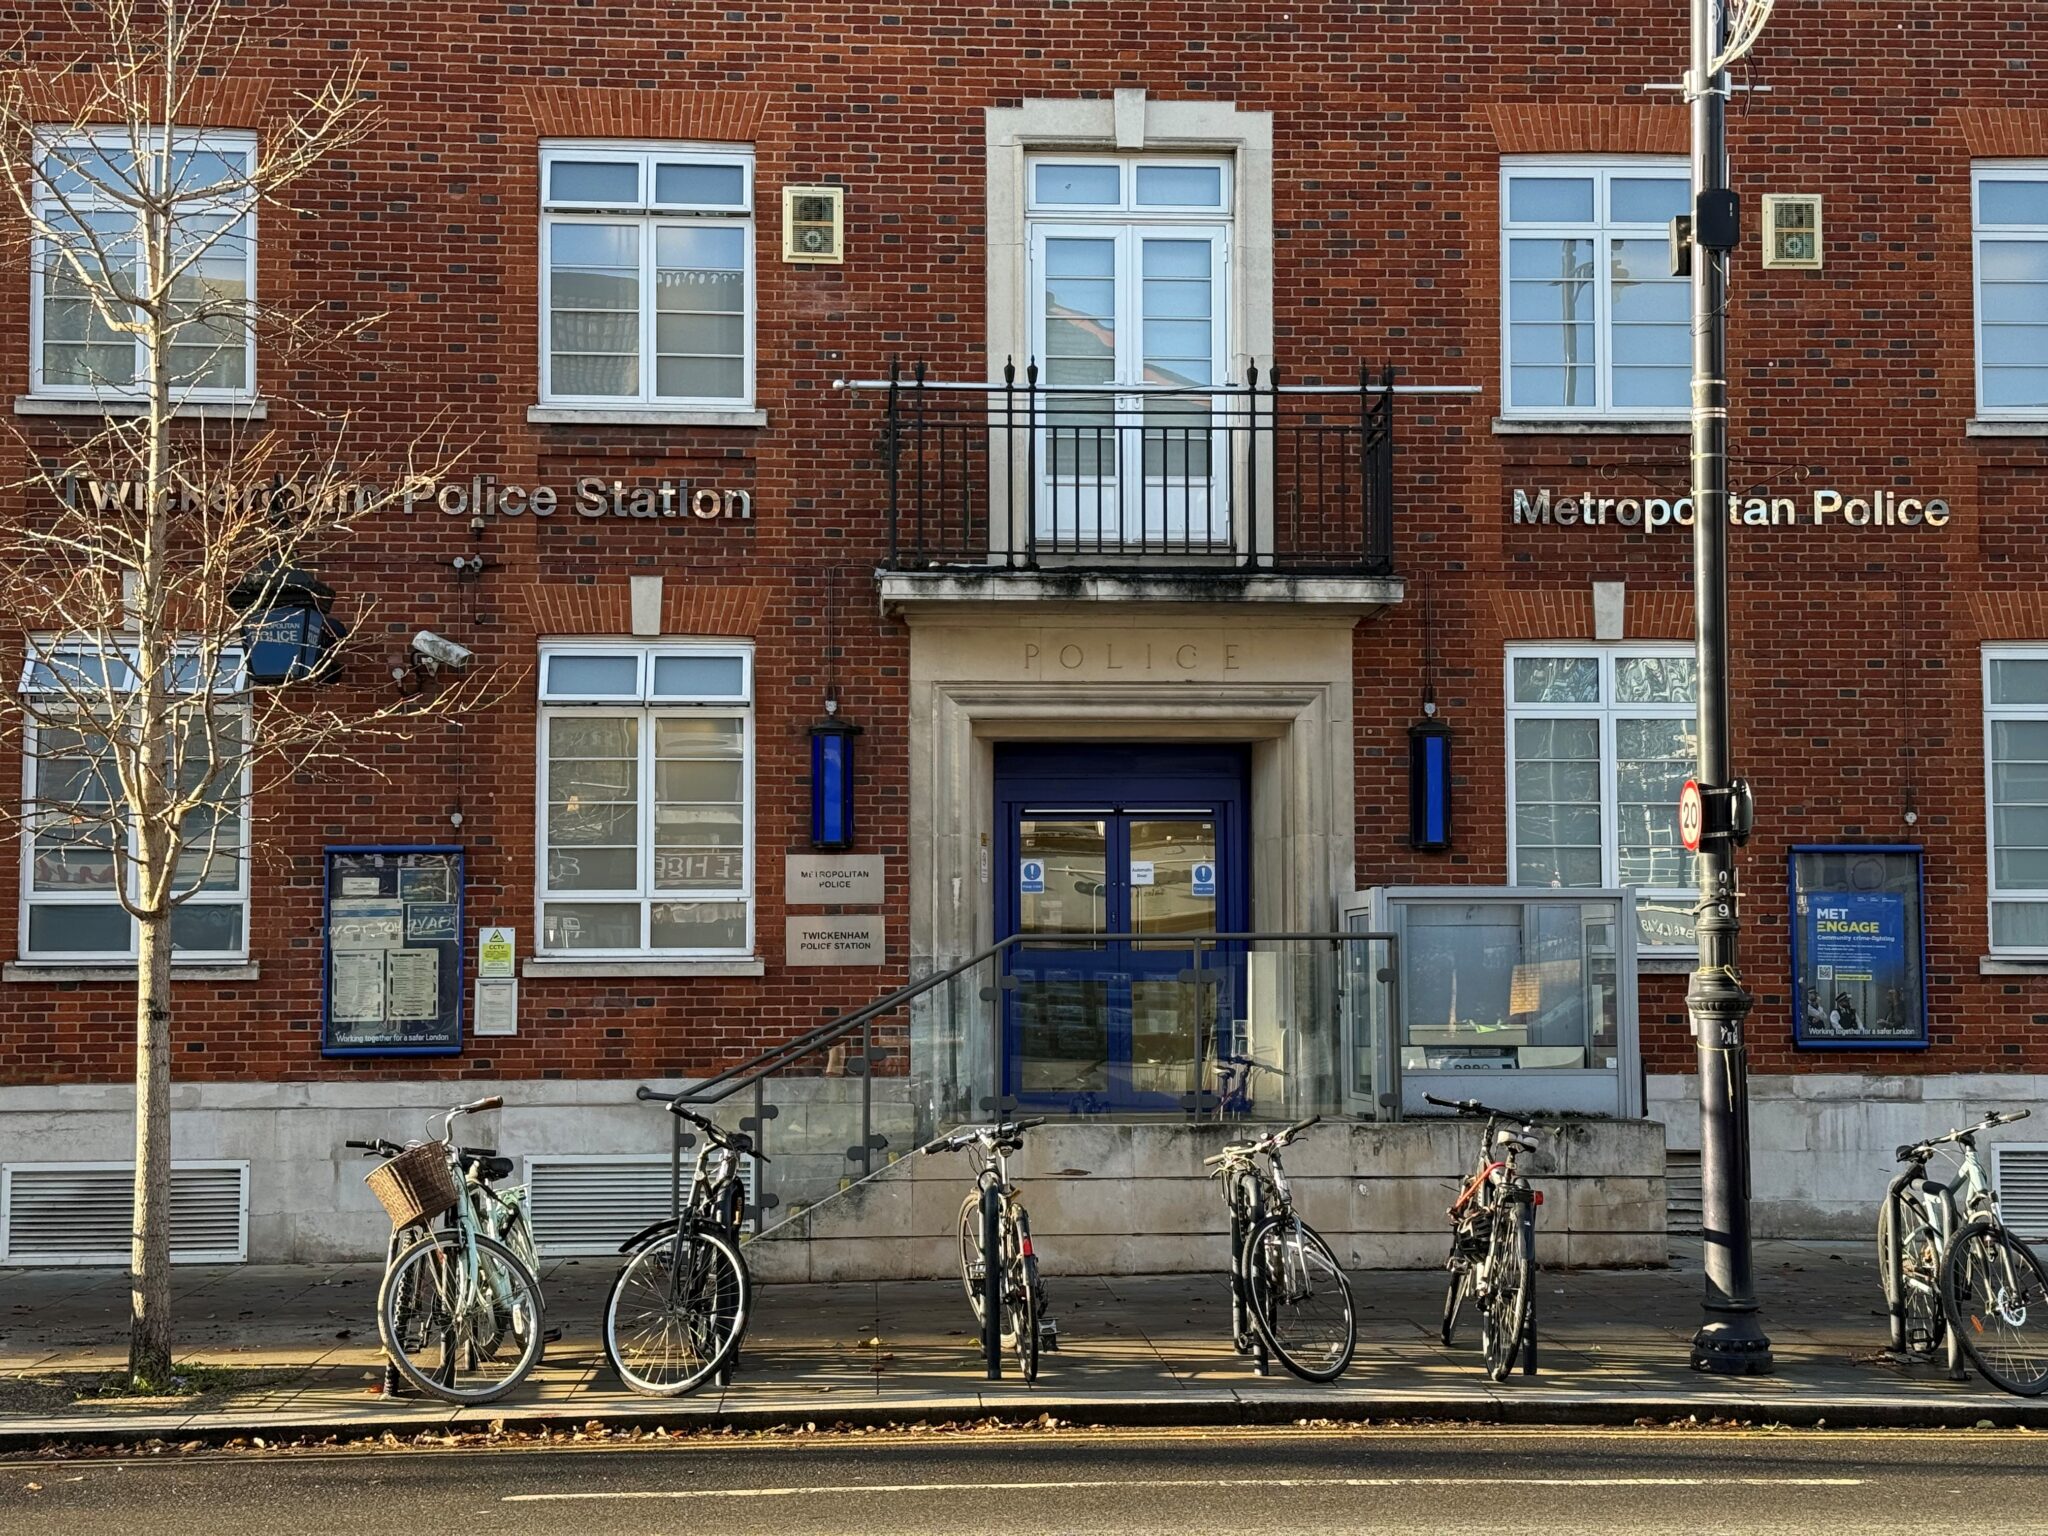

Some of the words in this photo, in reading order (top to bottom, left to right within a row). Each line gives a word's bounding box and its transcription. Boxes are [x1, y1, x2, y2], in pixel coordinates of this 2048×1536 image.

[403, 475, 558, 517] Police
[576, 477, 751, 519] Station
[1511, 489, 1796, 534] Metropotan
[1813, 489, 1950, 527] Police
[251, 630, 298, 642] POLICE
[1024, 643, 1240, 670] POLICE
[1683, 802, 1698, 829] 20
[819, 880, 851, 888] POLICE
[1816, 908, 1848, 920] MET
[1816, 921, 1879, 933] ENGAGE
[802, 931, 869, 940] TWICKENHAM
[800, 942, 831, 950] POLICE
[335, 1032, 363, 1043] Working
[365, 1034, 393, 1043] together
[393, 1033, 401, 1041] for
[408, 1033, 424, 1041] safer
[425, 1033, 449, 1041] London
[1808, 1027, 1834, 1036] Working
[1836, 1028, 1861, 1036] together
